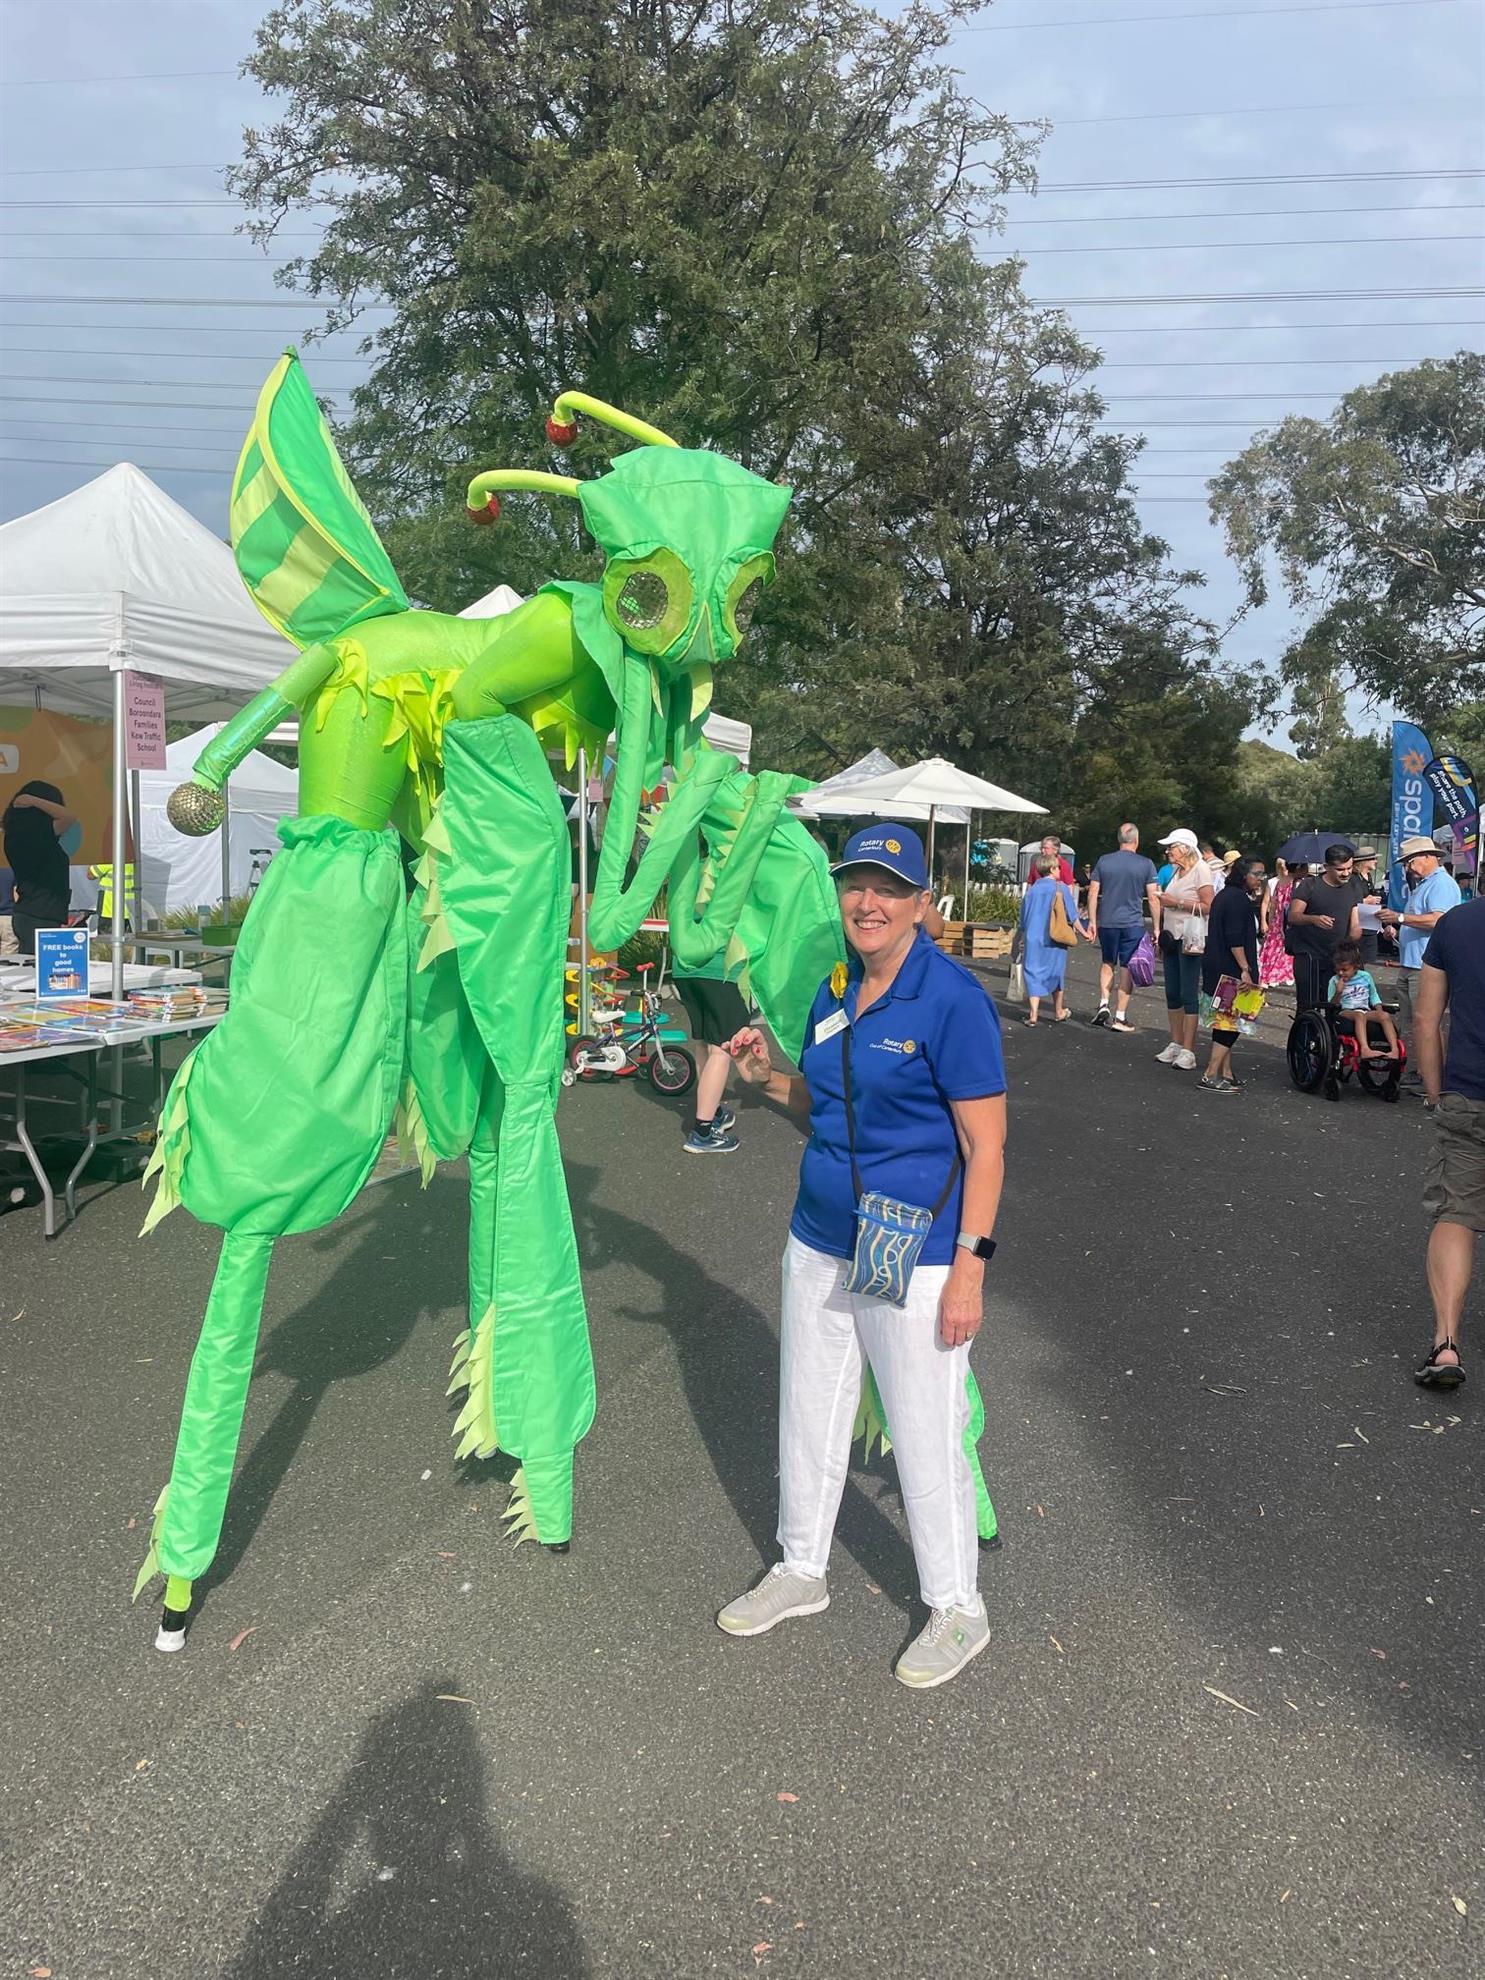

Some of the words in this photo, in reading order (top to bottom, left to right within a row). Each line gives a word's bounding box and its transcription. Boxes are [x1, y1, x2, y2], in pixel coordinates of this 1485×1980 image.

[134, 696, 156, 706] Council
[134, 720, 157, 729] Families
[144, 732, 161, 741] Traffic
[137, 743, 156, 752] School
[1429, 773, 1442, 788] play
[1438, 787, 1450, 802] your
[1449, 788, 1458, 800] the
[860, 839, 884, 848] Rotary
[883, 1038, 904, 1048] Rotary
